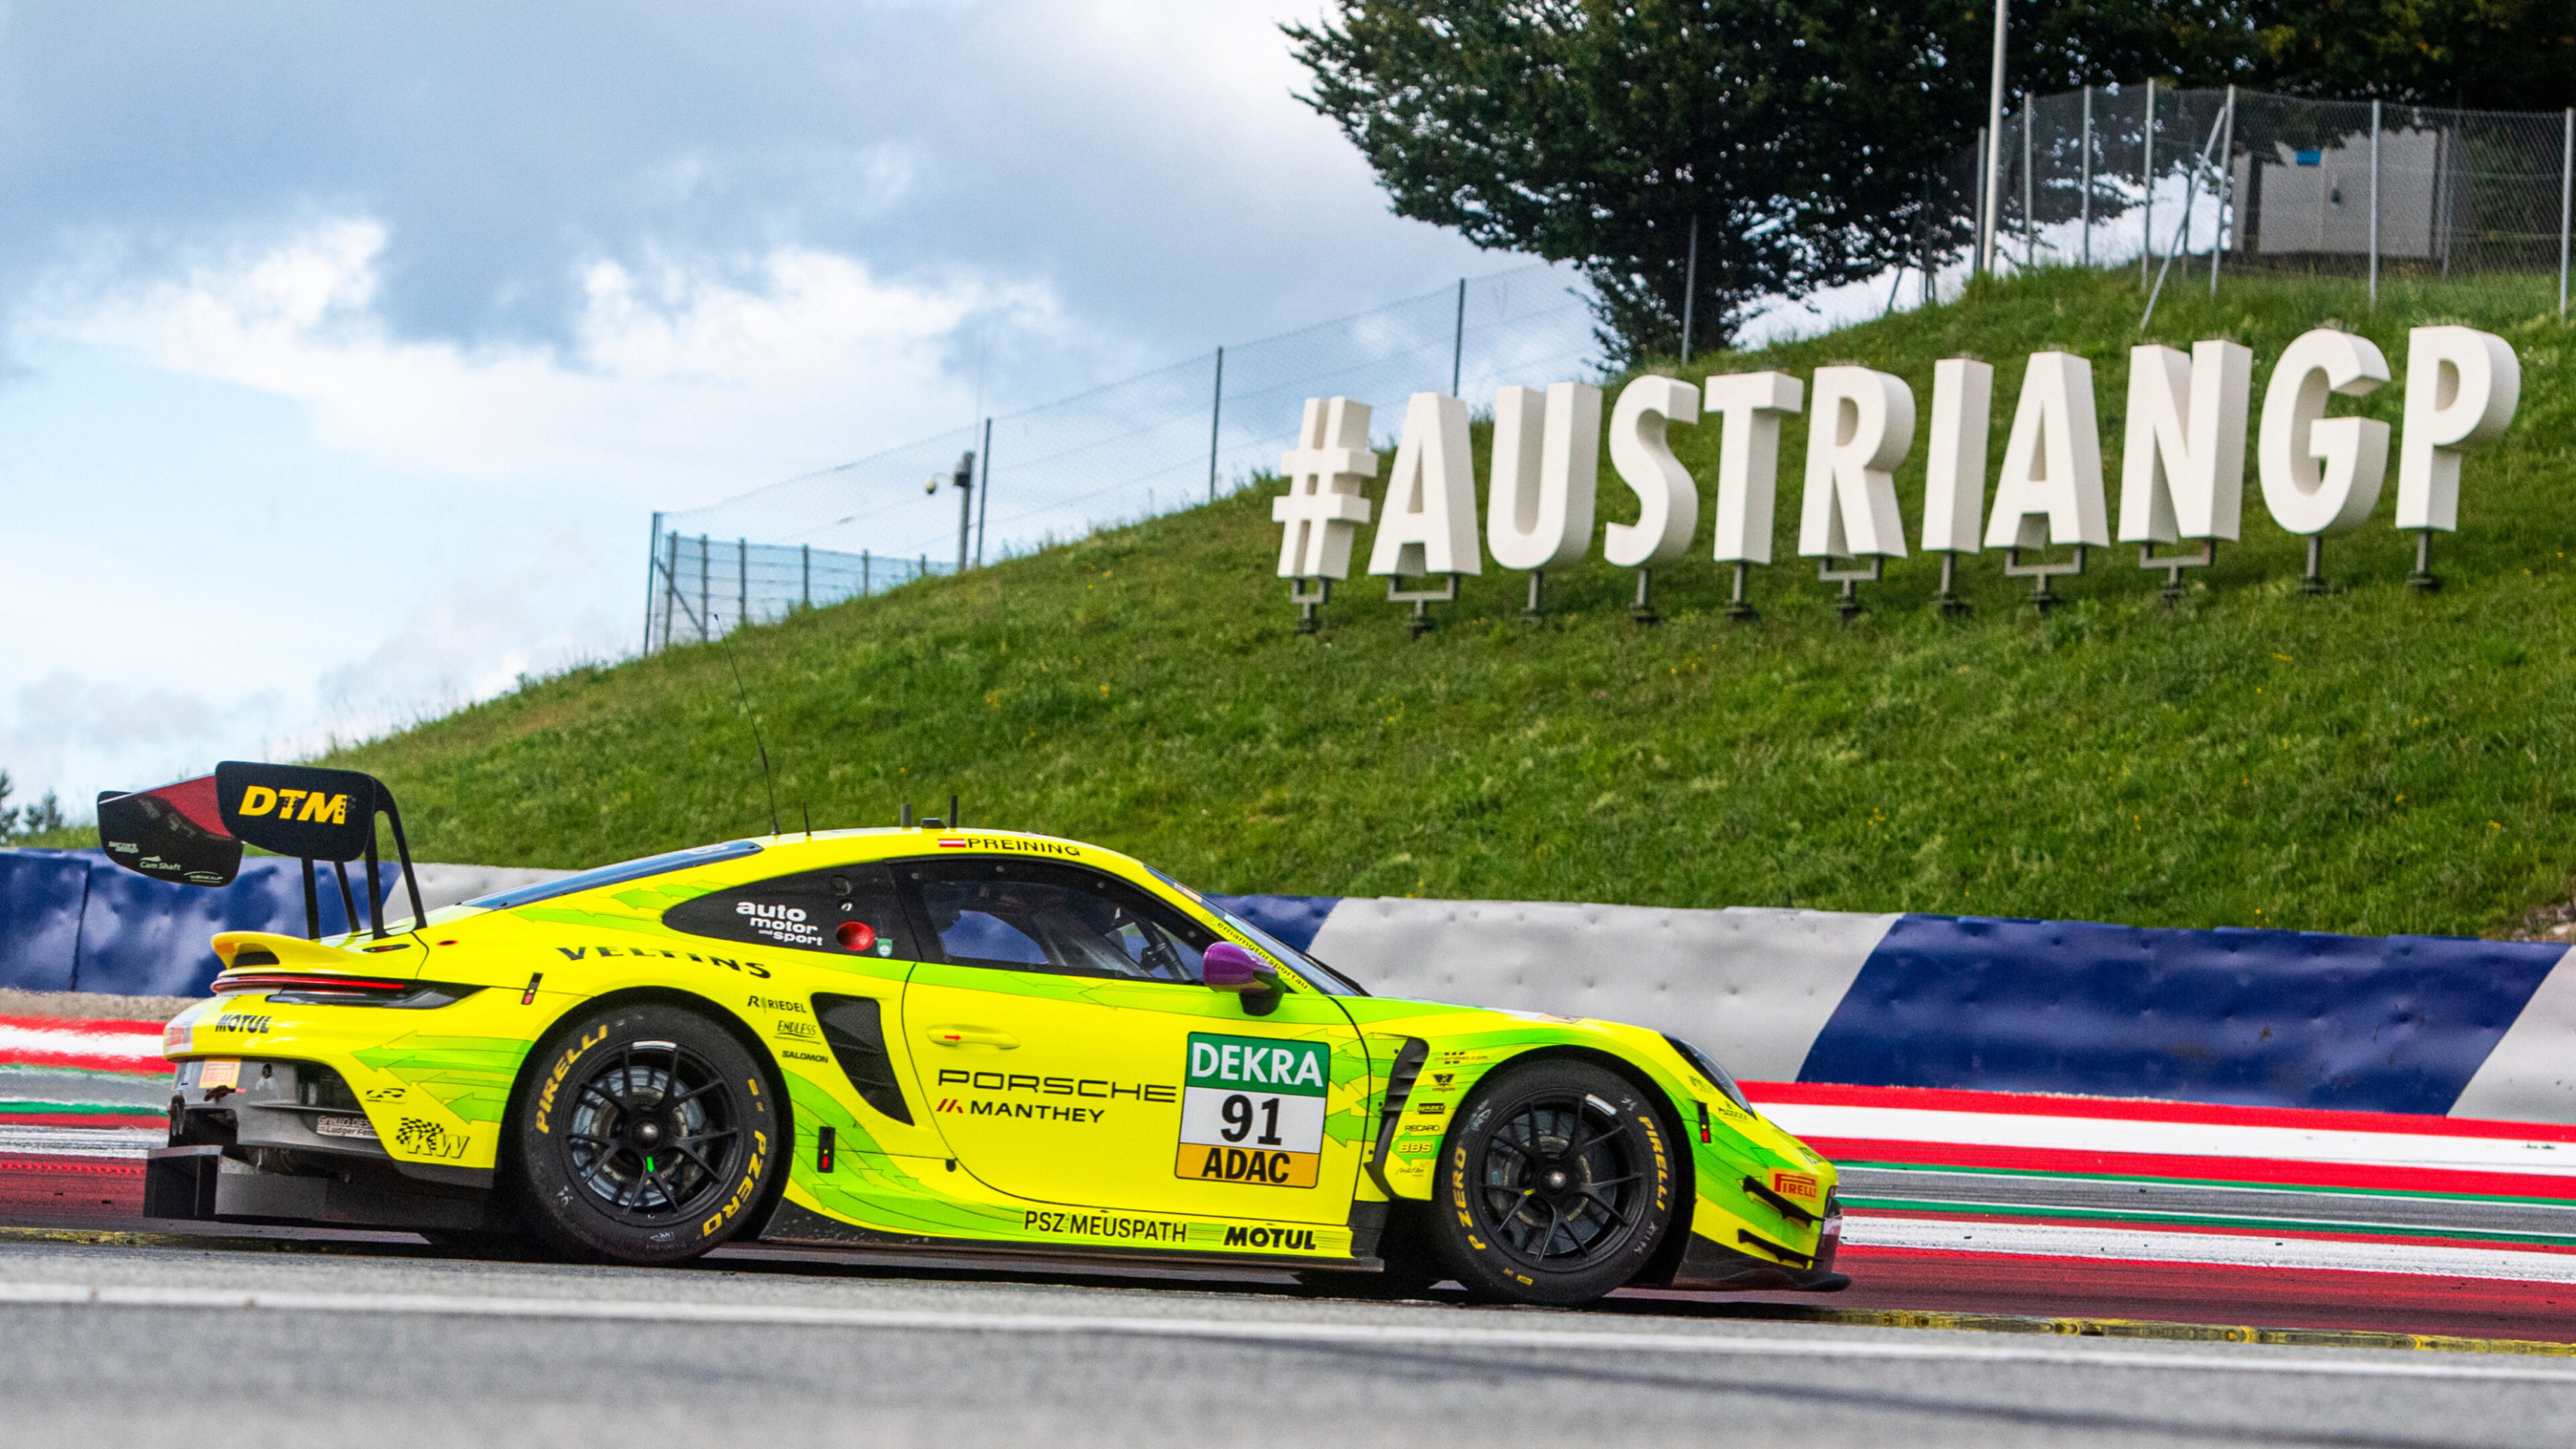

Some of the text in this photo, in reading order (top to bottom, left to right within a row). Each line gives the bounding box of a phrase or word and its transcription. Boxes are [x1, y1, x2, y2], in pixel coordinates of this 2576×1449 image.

[1271, 325, 2521, 580] #AUSTRIANGP
[238, 785, 348, 825] DTM
[967, 838, 1080, 856] PREINING
[140, 861, 182, 871] Cam Shaft
[735, 901, 807, 922] auto
[750, 917, 818, 935] motor
[773, 931, 823, 946] sport
[556, 946, 772, 979] VELTINS
[767, 999, 808, 1013] RIEDEL
[215, 1013, 272, 1034] MOTUL
[777, 1020, 817, 1036] ENDLESS
[782, 1050, 829, 1063] SALOMON
[1191, 1042, 1325, 1088] DEKRA
[537, 1024, 608, 1134] PIRELLI
[937, 1069, 1177, 1103] PORSCHE
[970, 1100, 1106, 1123] MANTHEY
[1220, 1094, 1283, 1147] 91
[406, 1130, 470, 1159] KW
[1398, 1142, 1432, 1154] BBS
[1201, 1148, 1292, 1184] ADAC
[1638, 1115, 1669, 1212] PIRELLI
[1774, 1173, 1817, 1199] PIRELLI
[1023, 1209, 1188, 1243] PSZ MEUSPATH
[1224, 1226, 1317, 1251] MOTUL
